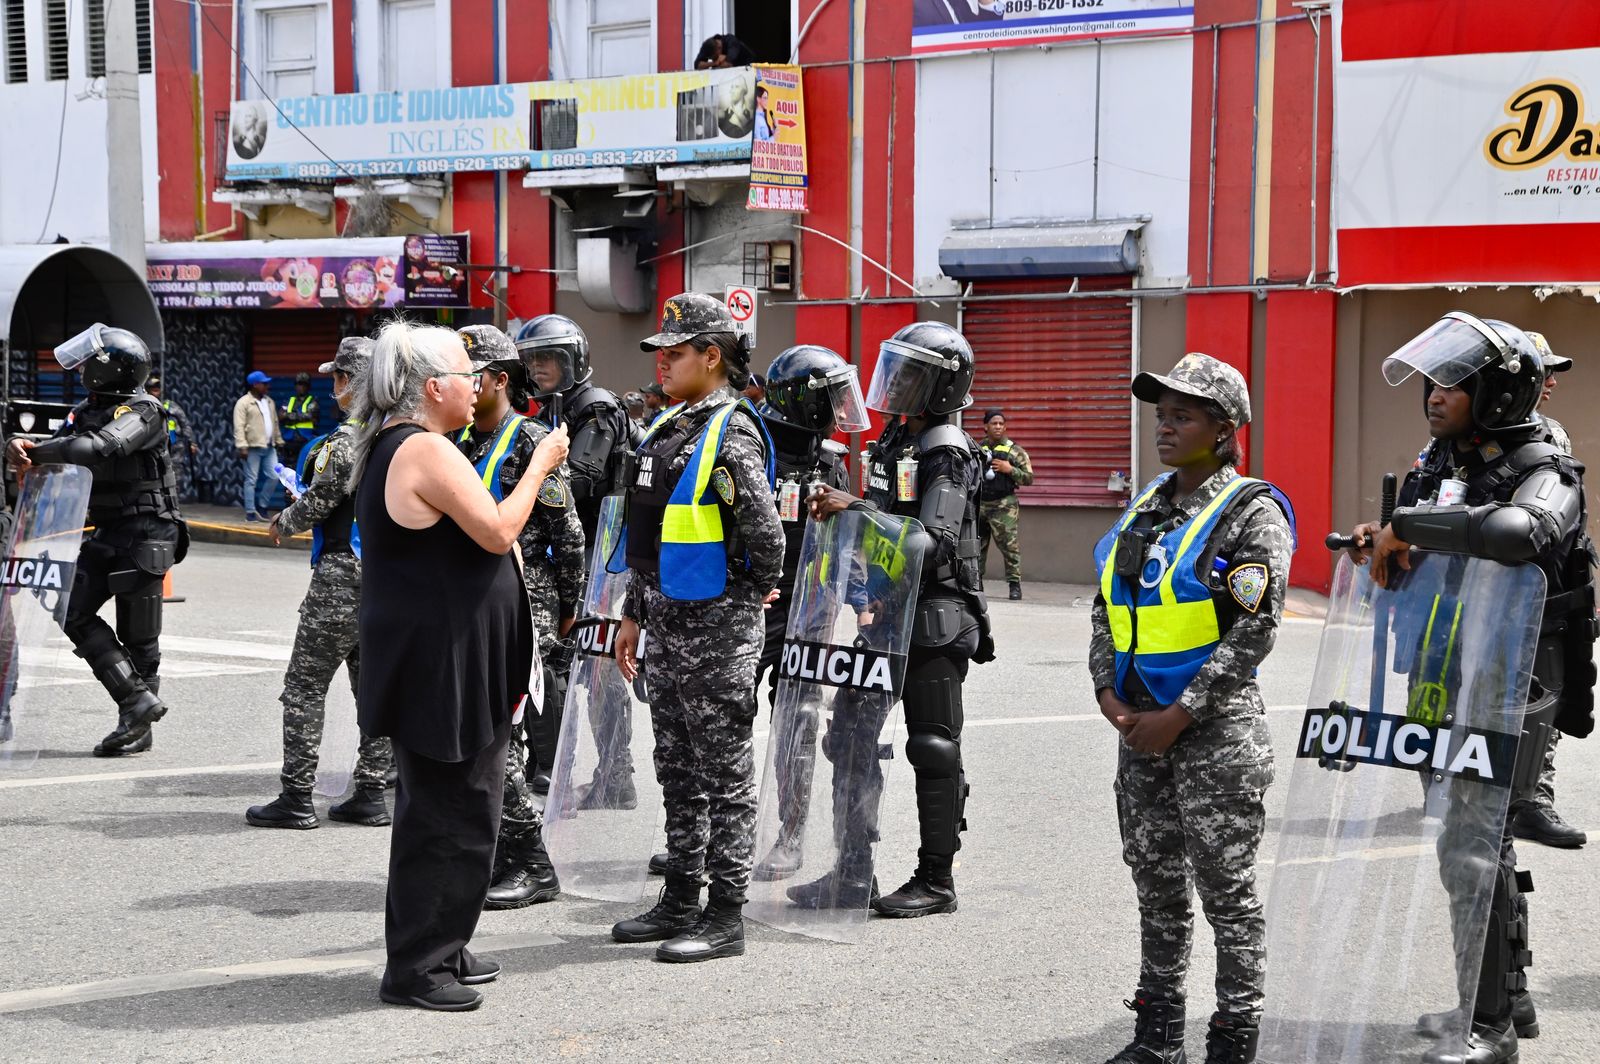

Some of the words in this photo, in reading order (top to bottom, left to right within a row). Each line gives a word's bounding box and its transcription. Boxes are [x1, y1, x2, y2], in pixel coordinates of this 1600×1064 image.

[962, 20, 1136, 40] centrodeidiomaswashington@gmail.com
[277, 94, 368, 129] CENTRO
[373, 91, 403, 124] DE
[408, 84, 514, 122] IDIOMAS
[1488, 83, 1600, 166] Da
[387, 123, 484, 154] INGLÉS
[551, 149, 678, 167] 809-833-2823
[777, 144, 803, 157] ORATORIA
[1546, 168, 1600, 182] RESTAU
[1530, 185, 1539, 195] el
[1542, 185, 1562, 195] Km.
[198, 282, 212, 292] DE
[213, 282, 245, 292] VIDEO
[246, 281, 287, 292] JUEGOS
[780, 643, 893, 692] POLICIA
[1303, 714, 1494, 779] POLICIA
